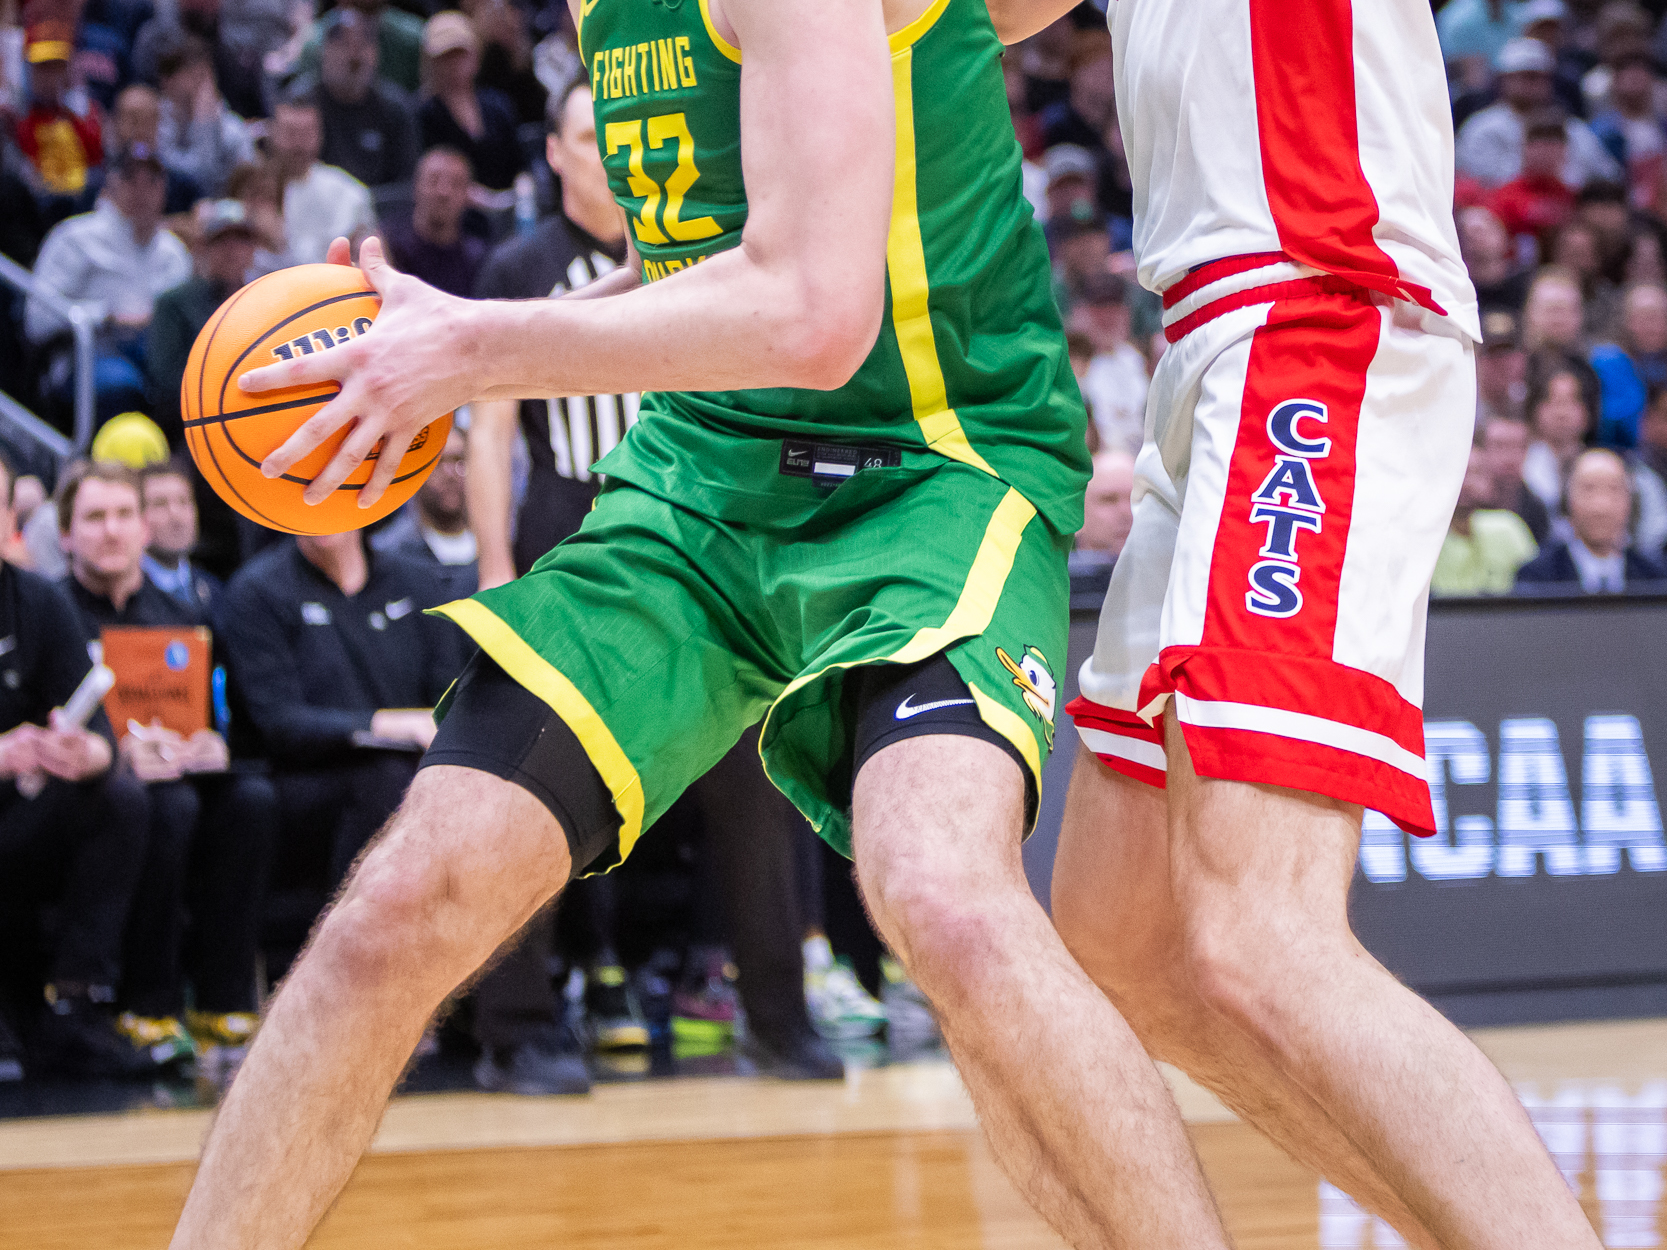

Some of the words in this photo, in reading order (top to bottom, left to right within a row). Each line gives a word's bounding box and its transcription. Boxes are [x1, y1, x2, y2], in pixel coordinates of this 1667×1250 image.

[593, 36, 697, 101] FIGHTING
[604, 112, 723, 244] 32
[863, 457, 883, 468] 48
[1245, 398, 1332, 618] CATS
